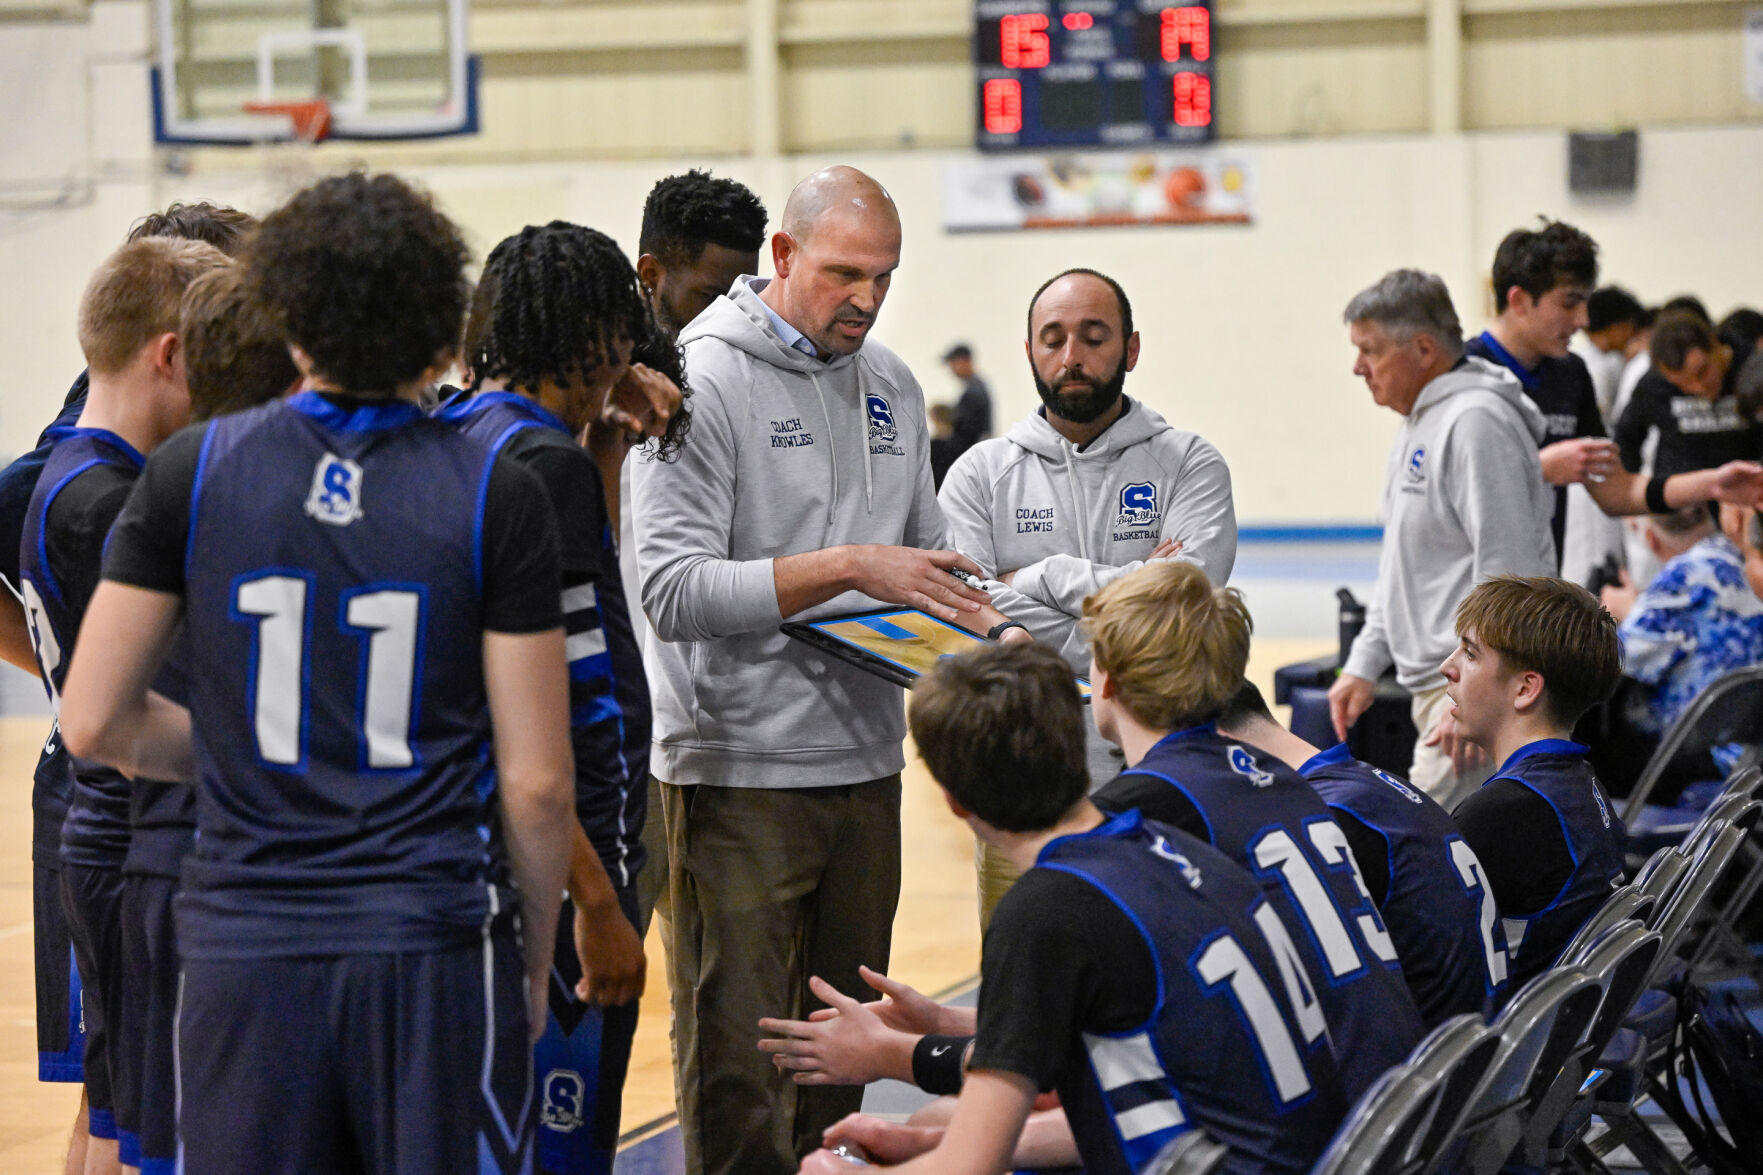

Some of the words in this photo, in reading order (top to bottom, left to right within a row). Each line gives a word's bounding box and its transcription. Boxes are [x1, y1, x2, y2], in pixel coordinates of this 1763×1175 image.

[1016, 508, 1054, 519] COACH
[1137, 510, 1162, 521] Blue
[1016, 521, 1053, 533] LEWIS
[236, 573, 420, 769] 11
[1196, 901, 1327, 1103] 14
